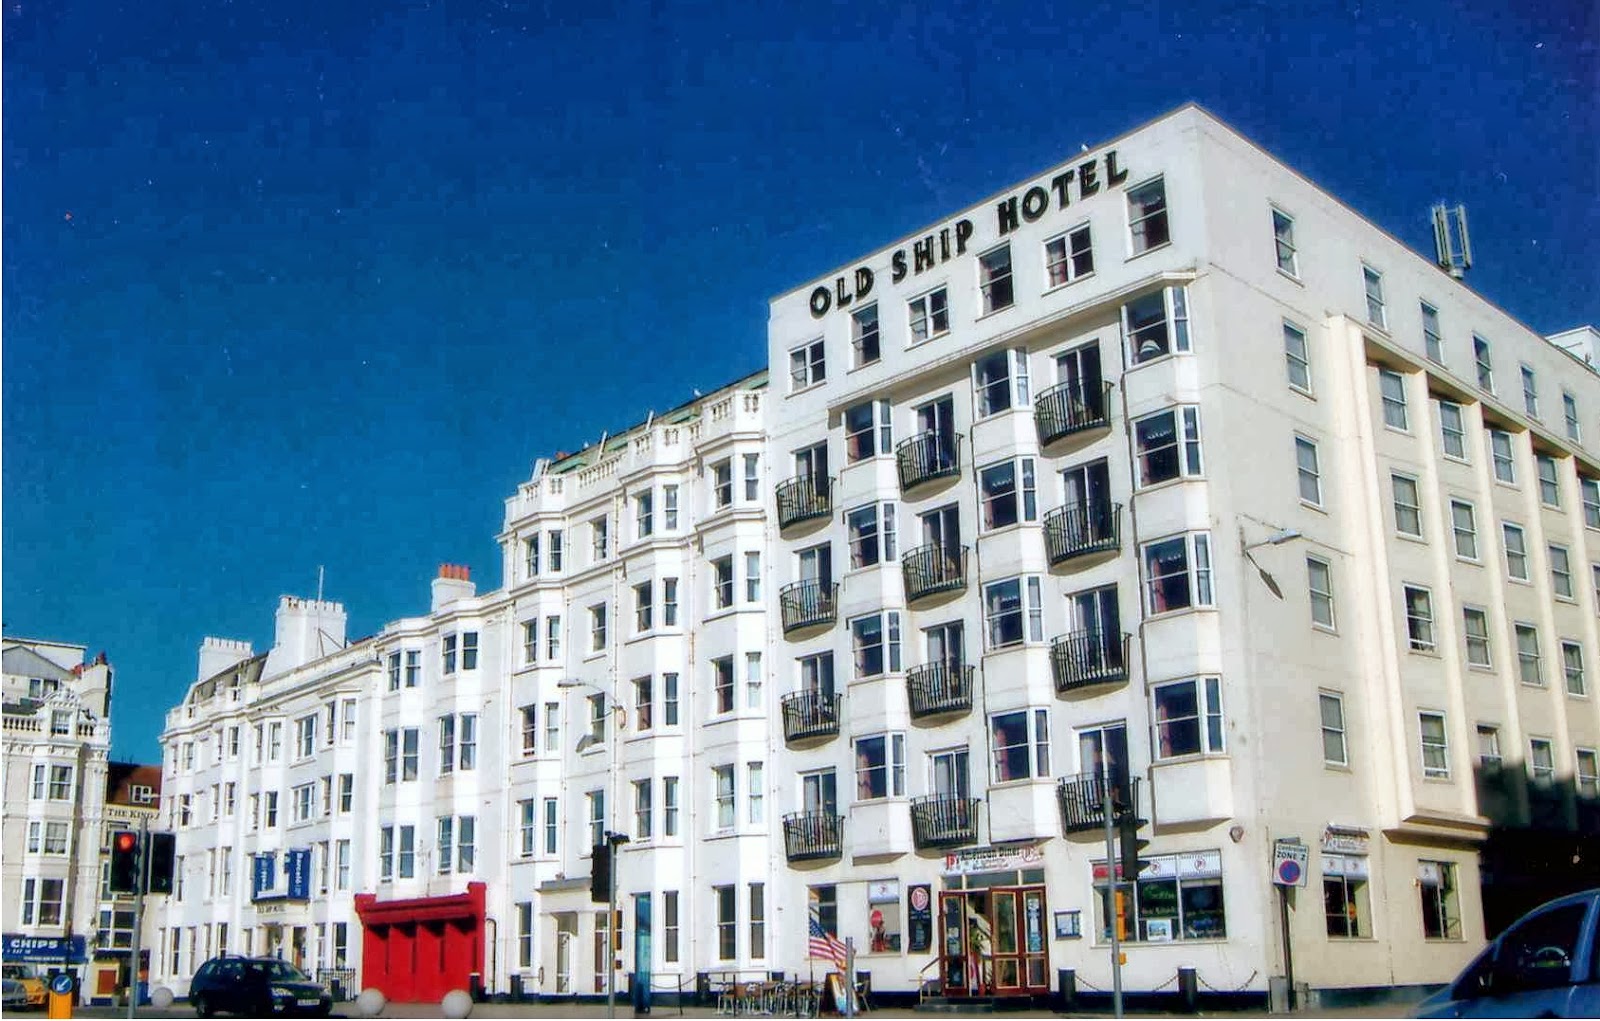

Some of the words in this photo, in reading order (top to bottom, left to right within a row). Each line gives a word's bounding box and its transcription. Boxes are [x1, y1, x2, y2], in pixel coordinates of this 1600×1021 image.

[809, 266, 874, 318] OLD
[892, 218, 973, 284] SHIP
[998, 150, 1128, 237] HOTEL
[1277, 850, 1297, 860] ZONE
[10, 939, 58, 949] CHIPS
